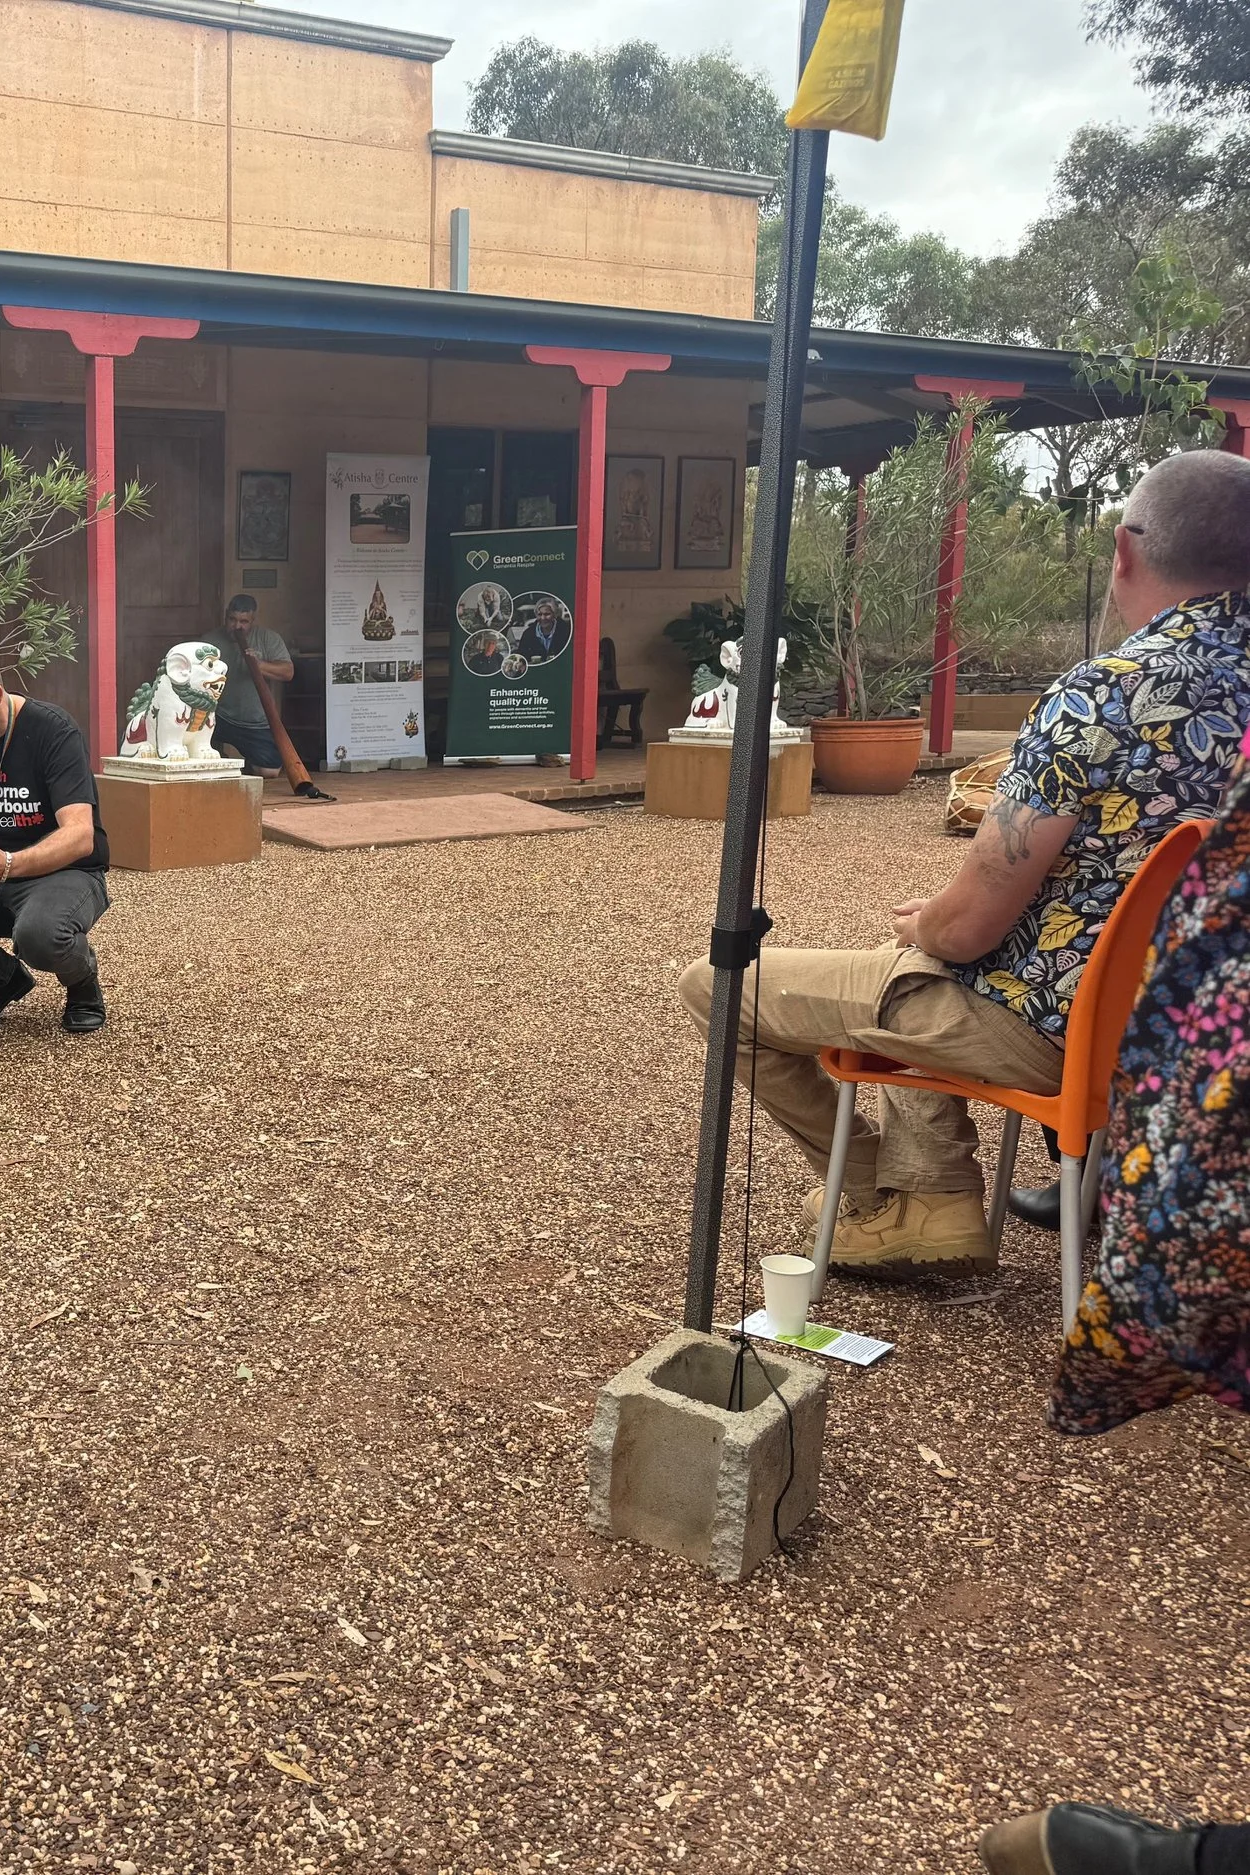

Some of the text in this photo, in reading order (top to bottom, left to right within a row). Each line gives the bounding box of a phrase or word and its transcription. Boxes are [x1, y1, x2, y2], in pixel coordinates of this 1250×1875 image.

[344, 472, 419, 483] Atisha Centre
[493, 552, 565, 563] GreenConnect
[490, 688, 539, 696] Enhancing
[490, 697, 549, 707] quality of life
